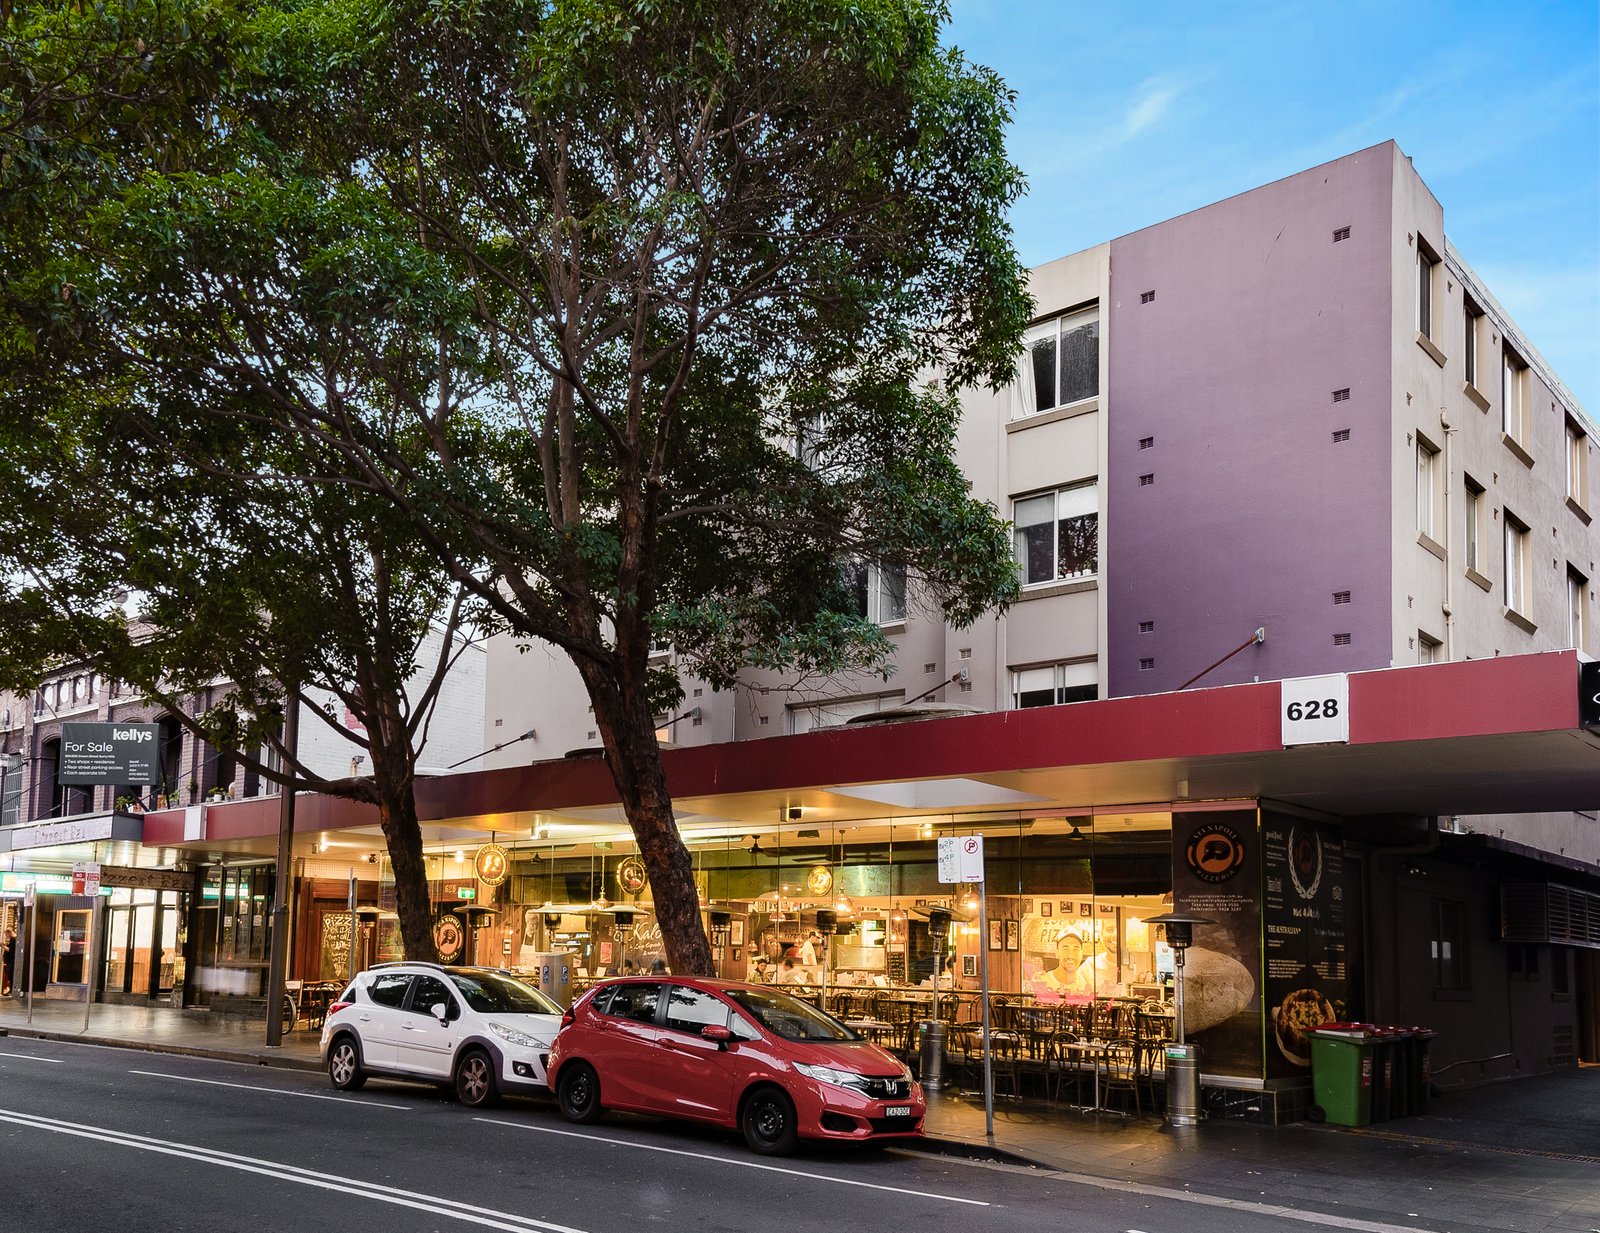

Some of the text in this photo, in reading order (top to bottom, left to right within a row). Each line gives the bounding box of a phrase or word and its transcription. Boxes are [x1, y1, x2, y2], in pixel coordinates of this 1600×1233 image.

[1287, 699, 1338, 721] 628
[112, 728, 152, 743] kellys
[64, 742, 113, 752] For Sale
[1207, 824, 1238, 840] NAPOLI
[1195, 869, 1235, 881] PIZZERIA
[444, 884, 456, 893] 628
